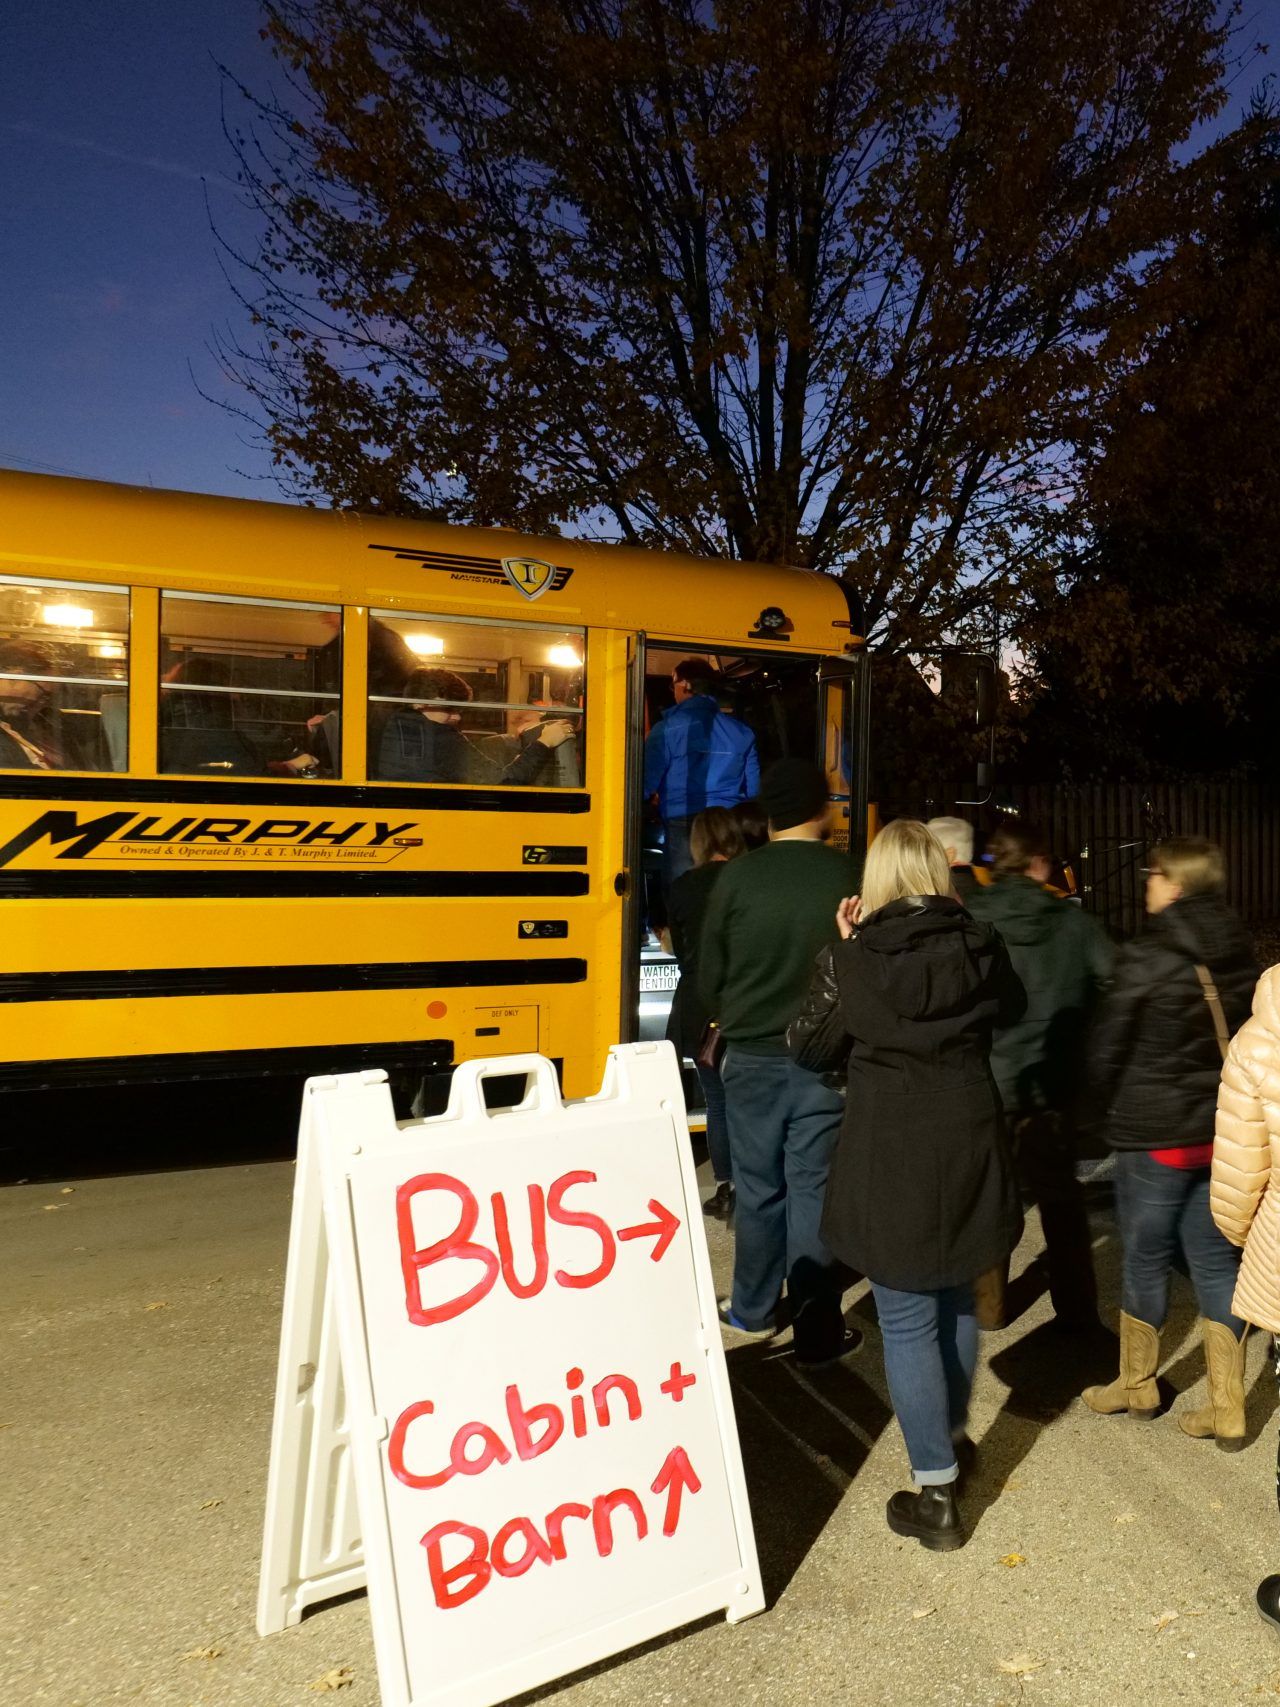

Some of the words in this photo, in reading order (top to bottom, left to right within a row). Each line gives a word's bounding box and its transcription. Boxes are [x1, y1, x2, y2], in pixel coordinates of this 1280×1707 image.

[450, 573, 500, 585] NAVISTAR
[0, 810, 420, 869] MURPHY
[120, 844, 162, 855] Owned
[164, 845, 174, 855] &
[178, 846, 230, 858] Operated
[233, 847, 247, 858] By
[250, 848, 261, 856] J.
[264, 848, 273, 857] &
[278, 848, 287, 857] T.
[291, 848, 334, 859] Murphy
[336, 849, 378, 858] Limited.
[643, 965, 676, 978] WATCH
[640, 977, 679, 990] TENTION
[491, 1010, 502, 1018] DEF
[504, 1009, 519, 1017] ONLY
[396, 1170, 616, 1327] BUS
[387, 1366, 643, 1491] Cabin
[420, 1487, 649, 1611] Barn
